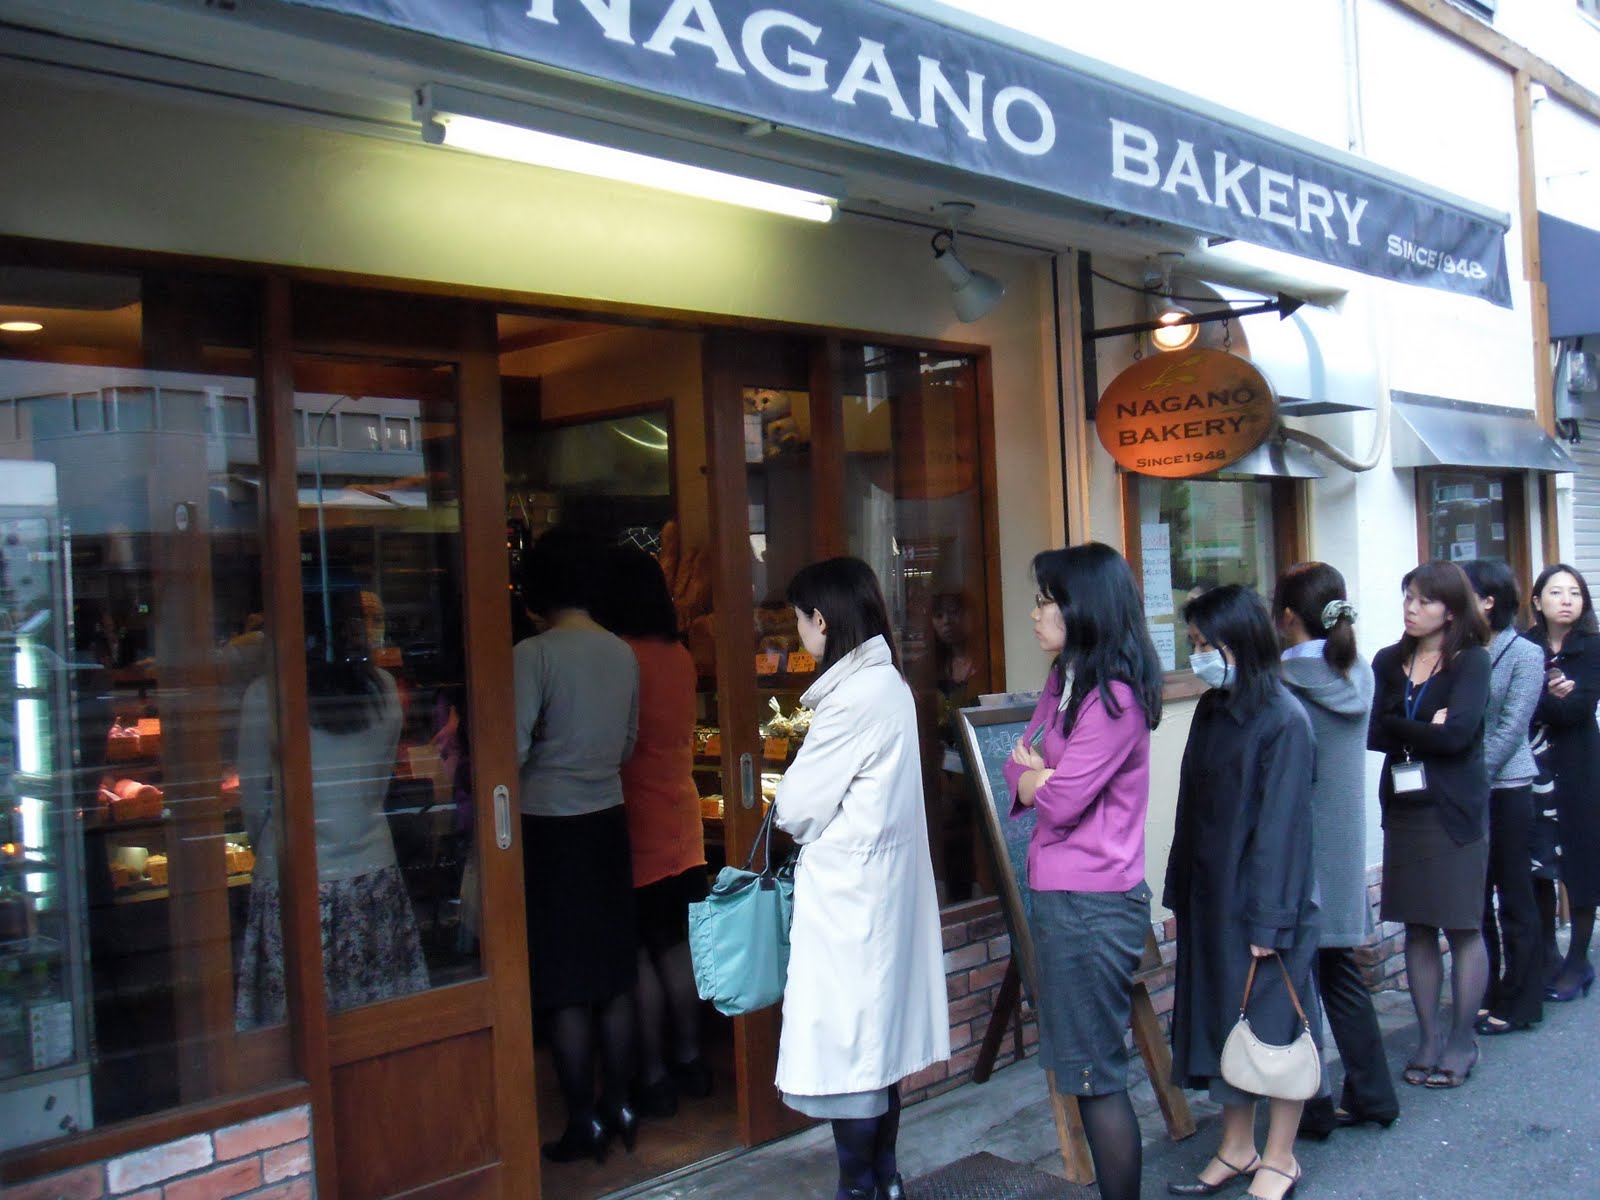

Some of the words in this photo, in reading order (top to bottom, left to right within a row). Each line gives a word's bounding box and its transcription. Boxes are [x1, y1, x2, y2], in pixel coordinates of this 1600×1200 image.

[1109, 117, 1369, 246] BAKERY
[1116, 386, 1255, 419] NAGANO
[1119, 416, 1246, 447] BAKERY
